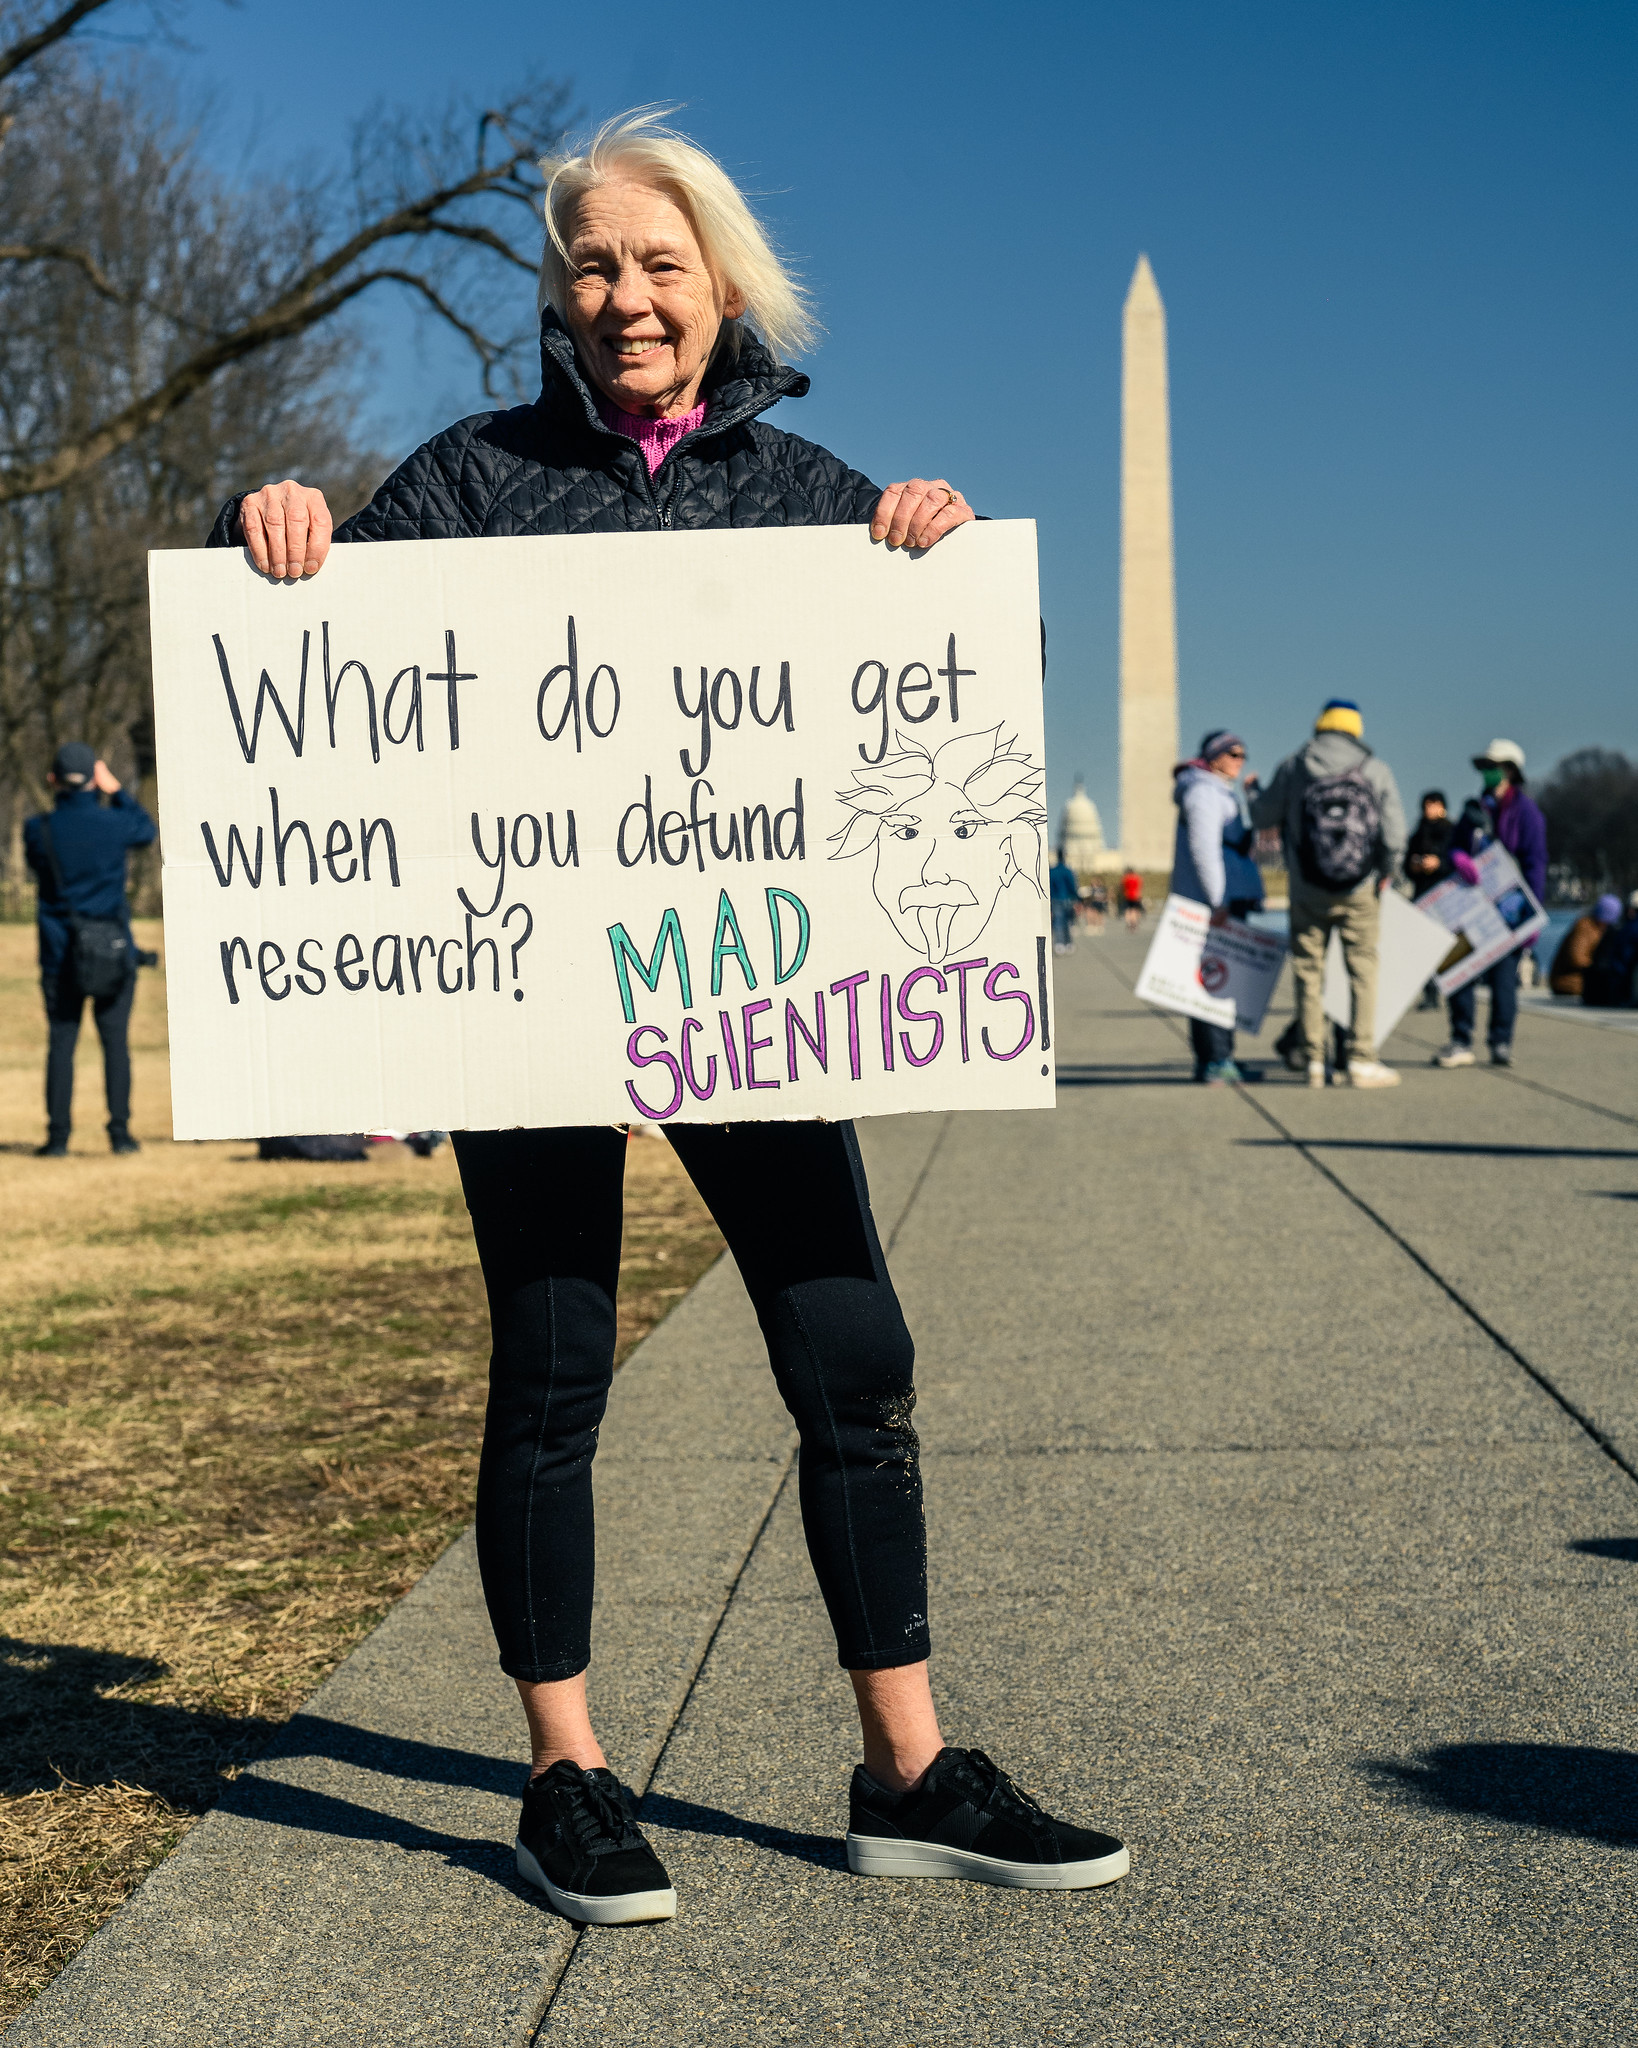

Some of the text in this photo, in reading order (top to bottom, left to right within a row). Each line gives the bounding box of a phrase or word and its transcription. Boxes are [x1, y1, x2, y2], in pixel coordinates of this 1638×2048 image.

[212, 616, 977, 777] What do you get
[201, 775, 806, 918] when you defund
[220, 903, 534, 1004] research?
[606, 887, 811, 1023] MAD
[625, 937, 1051, 1120] SCIENTISTS!
